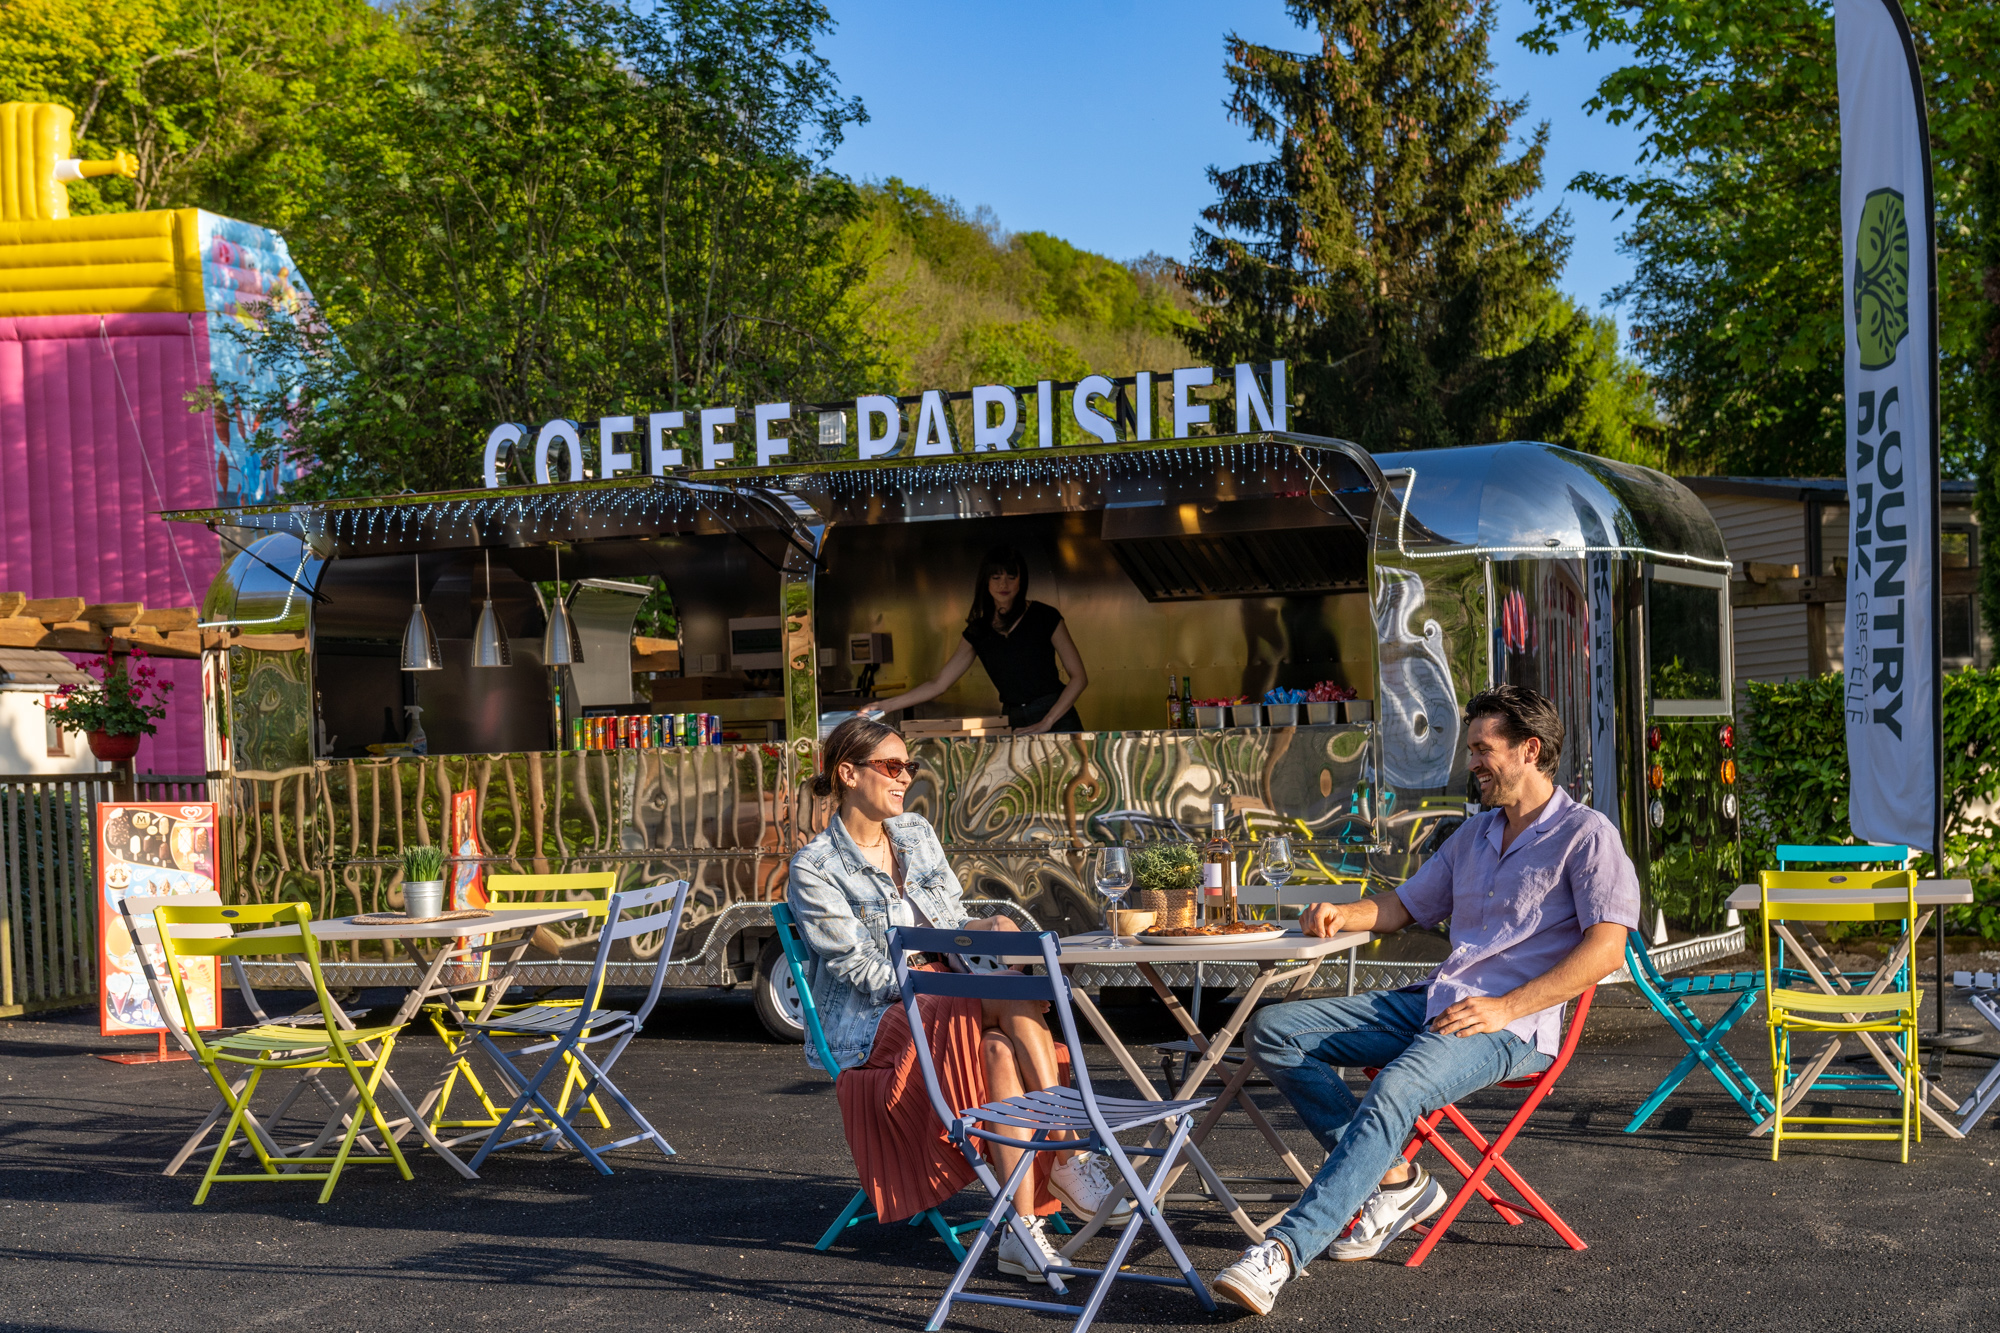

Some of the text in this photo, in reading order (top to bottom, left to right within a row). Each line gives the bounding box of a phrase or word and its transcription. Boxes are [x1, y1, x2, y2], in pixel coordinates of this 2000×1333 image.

[857, 359, 1288, 462] PARISIEN
[1854, 389, 1876, 581] PARK
[1872, 385, 1908, 742] COUNTRY
